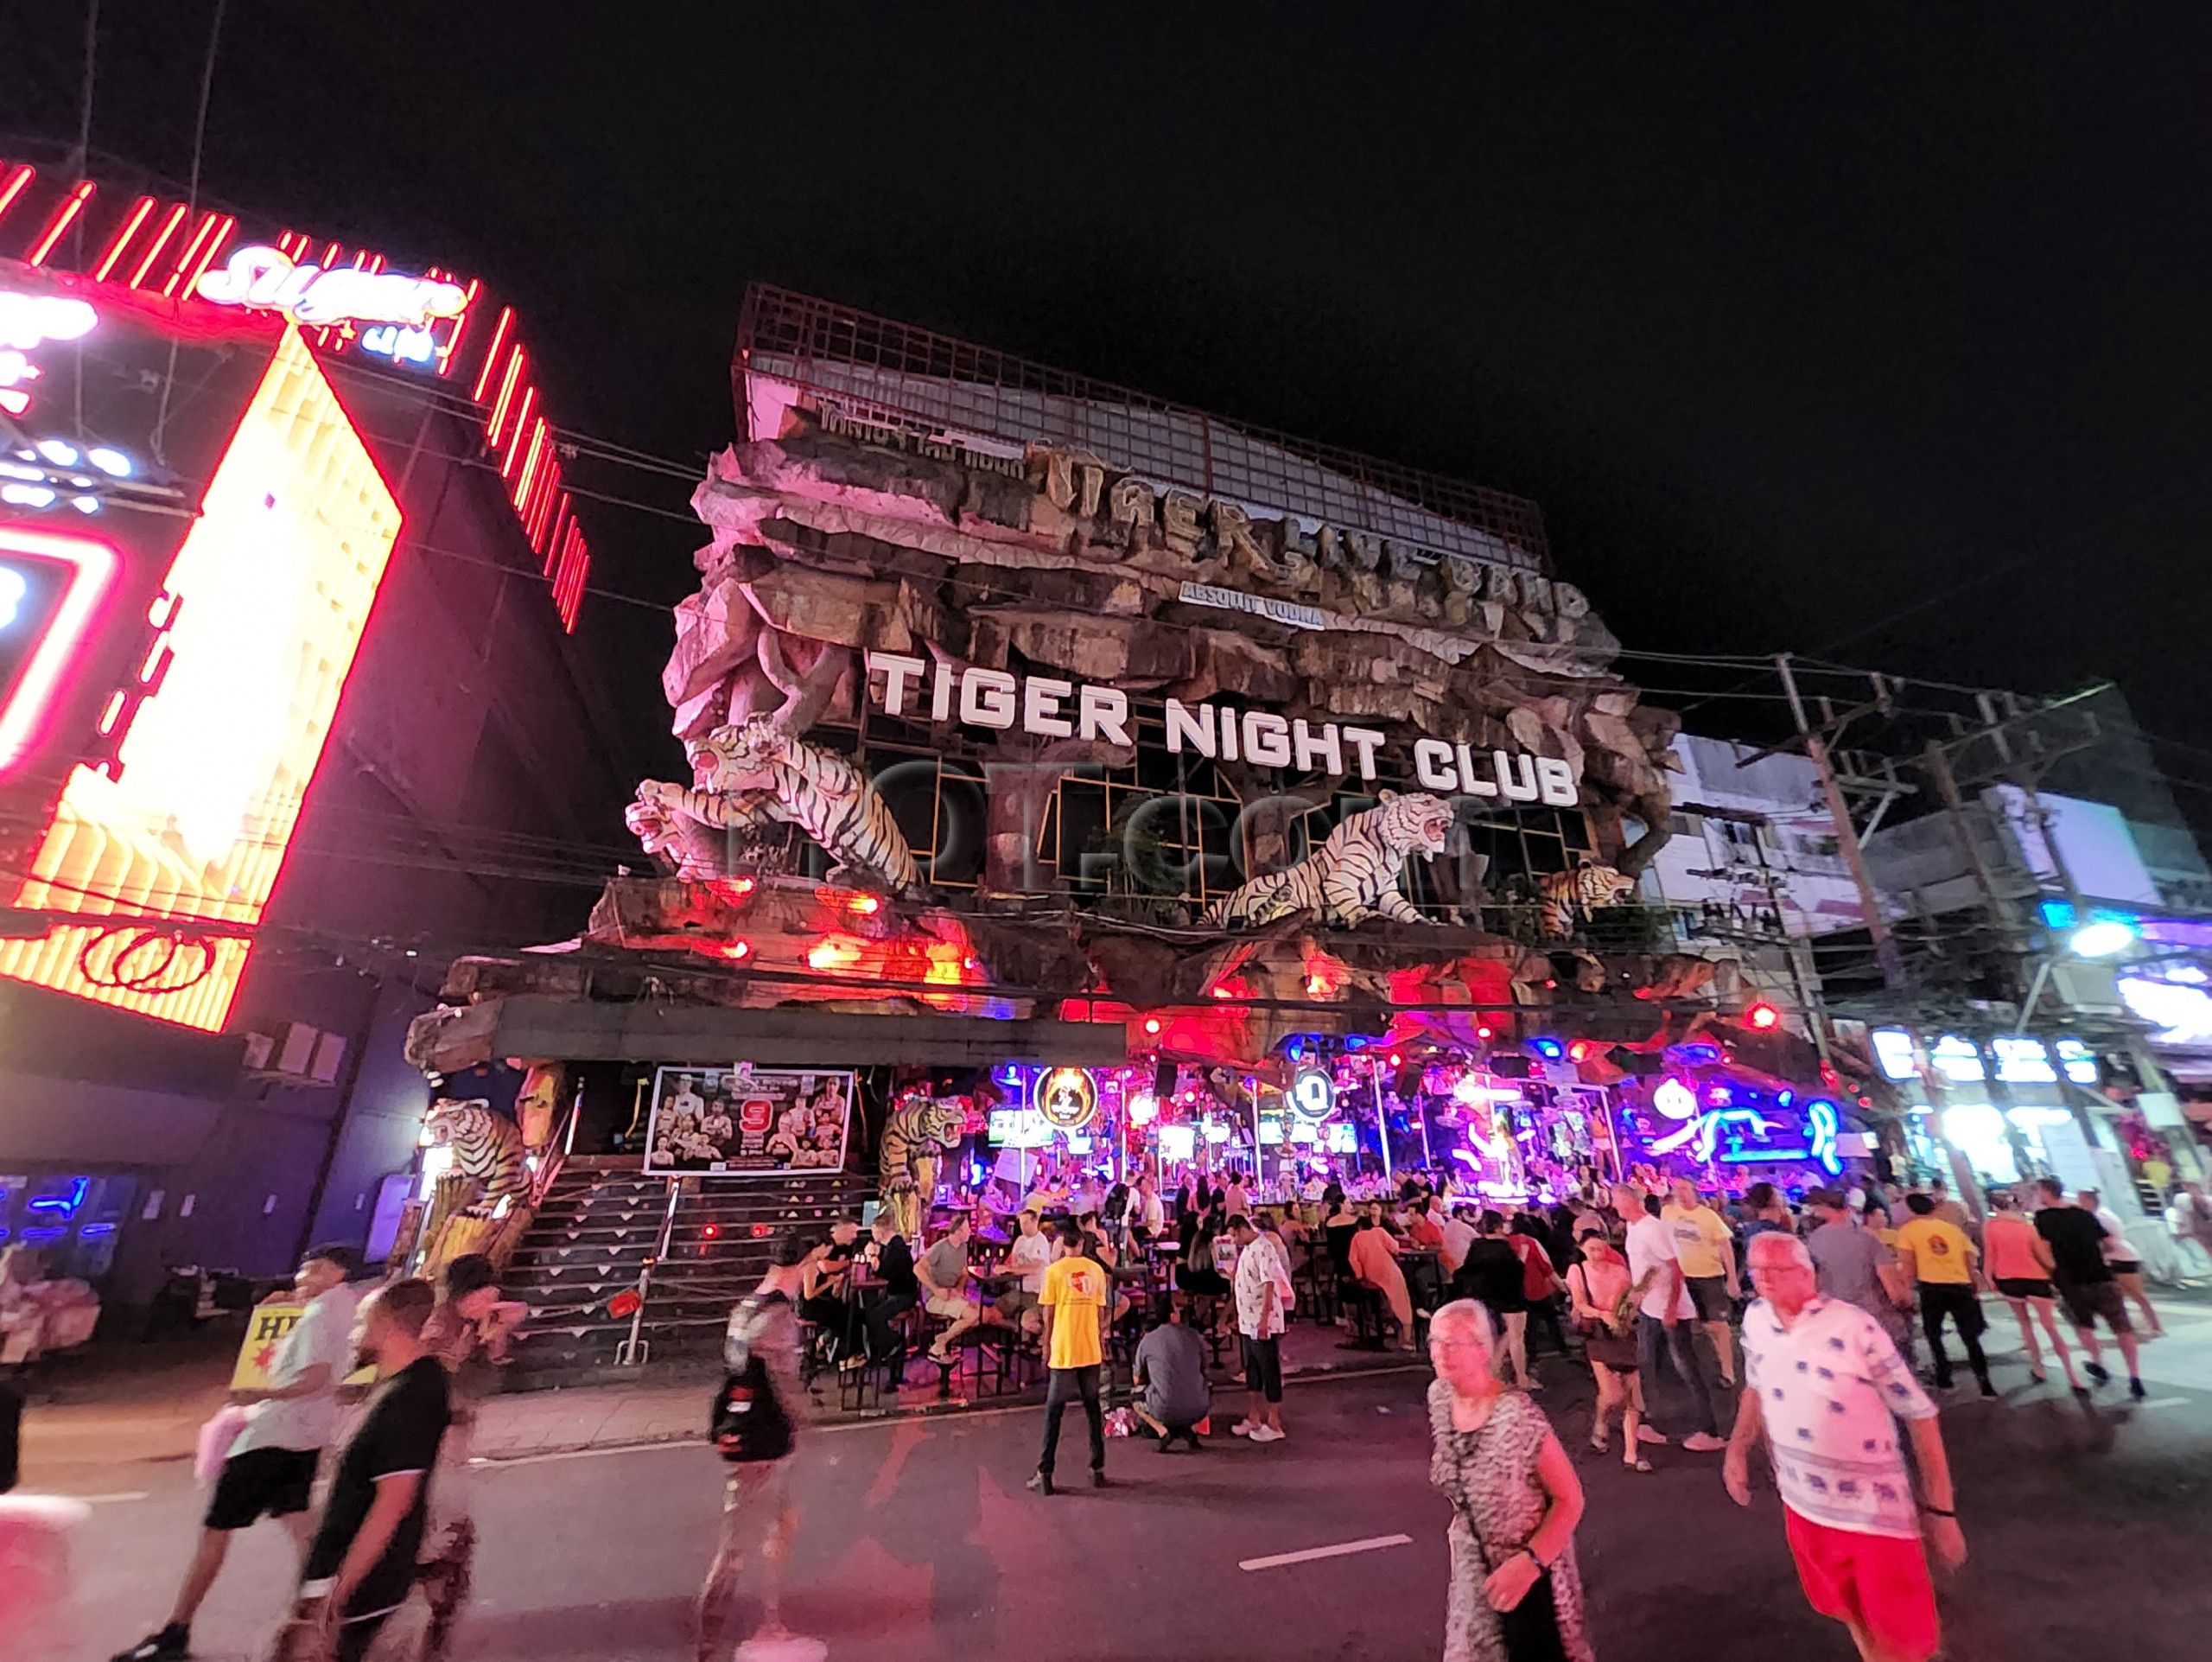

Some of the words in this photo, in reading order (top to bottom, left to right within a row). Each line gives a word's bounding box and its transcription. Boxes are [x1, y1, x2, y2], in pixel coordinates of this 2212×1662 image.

[1263, 598, 1325, 626] VODKA
[868, 652, 1134, 747] TIGER
[1165, 697, 1386, 781] NIGHT
[1414, 737, 1580, 807] CLUB
